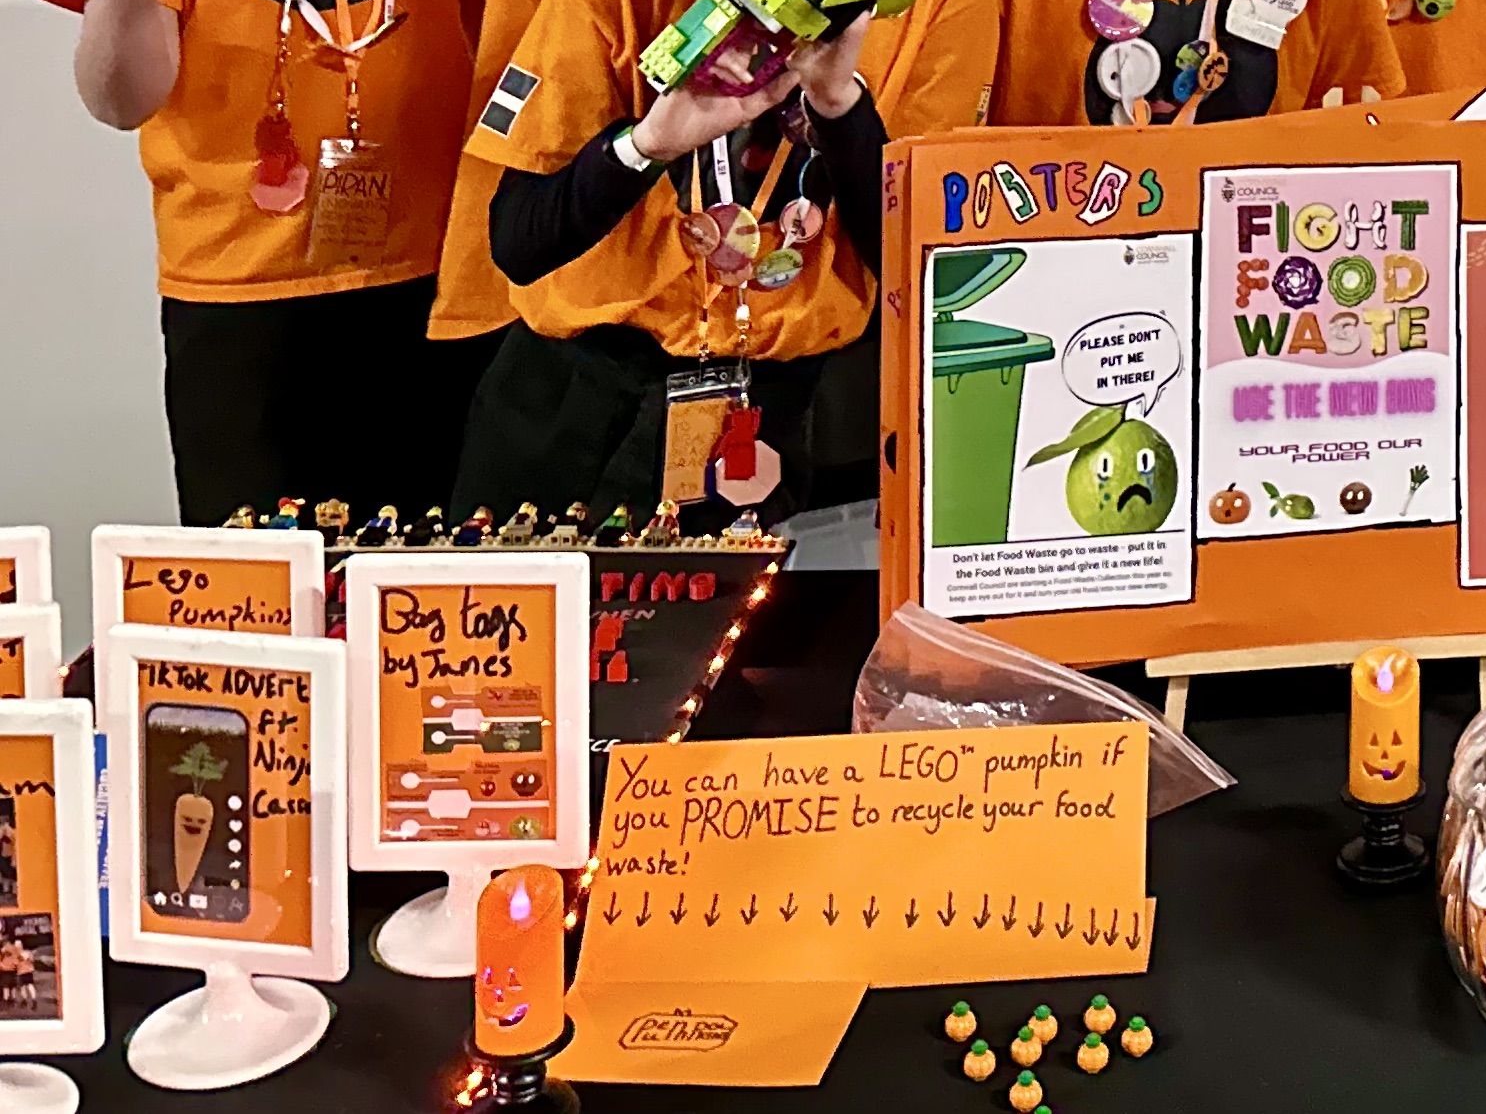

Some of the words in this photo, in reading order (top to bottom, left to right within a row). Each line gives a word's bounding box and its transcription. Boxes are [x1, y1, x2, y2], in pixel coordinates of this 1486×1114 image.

[942, 162, 1164, 233] POSTERS
[1236, 187, 1279, 197] COUNCIL
[1237, 199, 1429, 253] FIGHT
[1236, 254, 1429, 309] FOOD
[1080, 334, 1125, 351] PLEASE
[1128, 329, 1161, 343] DON'T
[1234, 306, 1429, 357] WASTE
[1100, 355, 1123, 368] PUT
[1128, 352, 1144, 364] ME
[1096, 376, 1109, 389] IN
[1112, 370, 1155, 386] THERE!
[1232, 384, 1275, 422] USE
[1283, 382, 1322, 419] THE
[1328, 380, 1379, 418] NEW
[1239, 444, 1300, 457] YOUR
[1308, 441, 1369, 453] FOOD
[1378, 438, 1423, 450] OUR
[1292, 450, 1370, 464] POWER
[953, 553, 979, 564] Don't
[981, 551, 995, 562] let
[997, 549, 1023, 561] Food
[1025, 548, 1058, 559] Waste
[1059, 548, 1073, 558] go
[1075, 546, 1086, 555] to
[1088, 544, 1119, 554] waste
[1127, 542, 1145, 553] put
[1147, 540, 1155, 550] it
[1156, 540, 1167, 550] in
[956, 568, 973, 579] the
[975, 566, 1001, 578] Food
[1003, 565, 1036, 576] Waste
[1038, 563, 1054, 574] bin
[1057, 561, 1076, 572] and
[1077, 560, 1100, 573] give
[1101, 559, 1109, 569] it
[1110, 560, 1118, 568] a
[1119, 559, 1141, 568] new
[124, 559, 210, 595] Lego
[380, 588, 446, 643] Bag
[460, 586, 528, 652] tags
[382, 646, 419, 688] by
[421, 648, 512, 679] James
[615, 754, 672, 802] You
[684, 772, 738, 793] can
[763, 752, 829, 787] have
[843, 765, 865, 783] a
[983, 734, 1083, 793] pumpkin
[1102, 735, 1129, 767] if
[612, 809, 669, 849] you
[680, 796, 840, 846] PROMISE
[852, 793, 880, 827] to
[891, 793, 975, 835] recycle
[982, 800, 1044, 832] your
[1055, 789, 1116, 819] food
[605, 848, 691, 876] waste!
